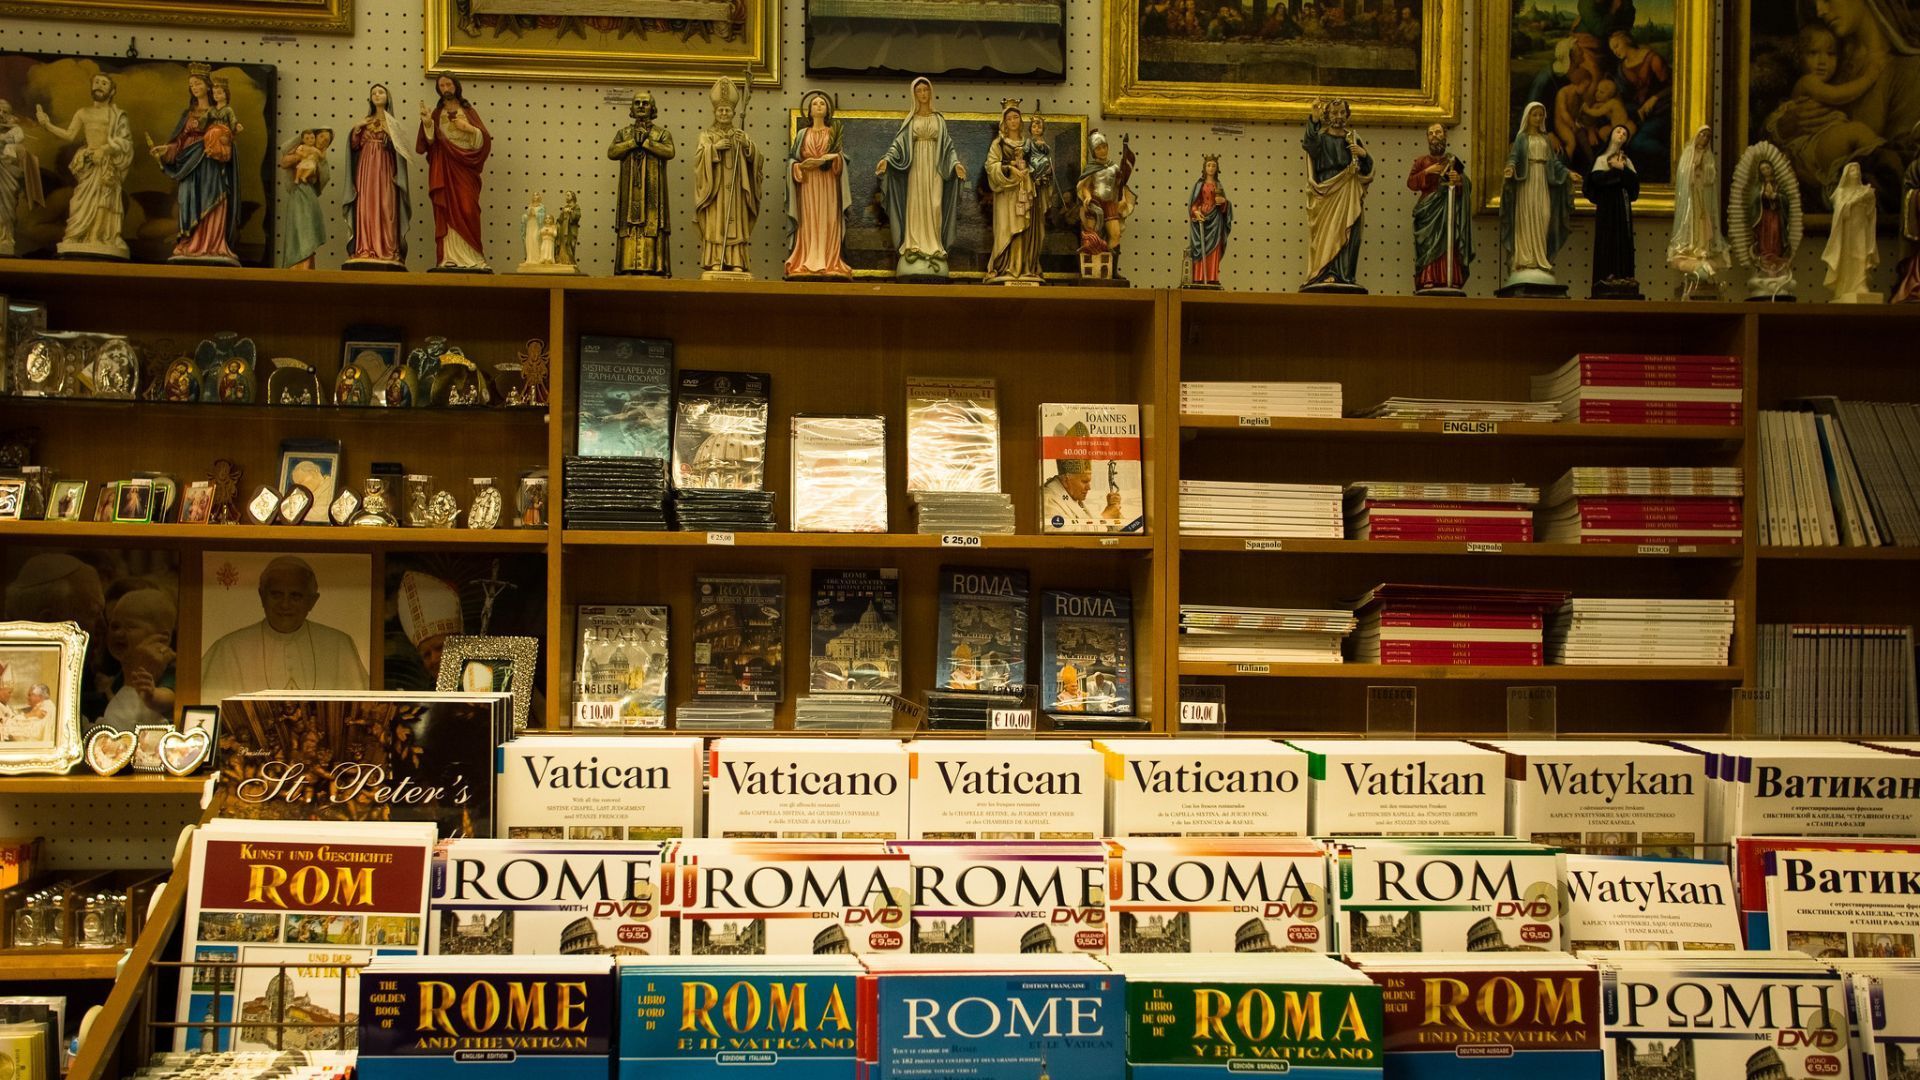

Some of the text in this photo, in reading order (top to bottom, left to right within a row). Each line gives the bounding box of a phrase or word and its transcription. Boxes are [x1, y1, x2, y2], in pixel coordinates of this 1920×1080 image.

[583, 364, 665, 375] SISTINE CHAPEL AND
[628, 374, 659, 383] ROOMS
[981, 390, 990, 399] II
[1086, 412, 1126, 422] IOANNES
[1240, 416, 1269, 426] English
[1090, 424, 1136, 434] PAULUS II
[1443, 422, 1494, 432] ENGLISH
[943, 536, 979, 545] € 25,00
[1246, 540, 1282, 550] Spagnolo
[1467, 543, 1502, 552] Spagnolo
[953, 574, 1014, 595] ROMA
[719, 585, 761, 596] ROMA
[1056, 595, 1117, 616] ROMA
[594, 626, 653, 642] ITALY
[1237, 664, 1268, 672] Italiano
[579, 683, 619, 694] ENGLISH
[1372, 688, 1412, 699] TEDESCO
[1742, 690, 1770, 700] RUSSO
[582, 705, 614, 719] € 10.00
[1182, 704, 1188, 719] €
[995, 712, 1030, 728] € 10.00
[521, 756, 671, 789] Vatican
[936, 761, 1083, 794] Vatican
[1129, 761, 1299, 793] Vaticano
[1341, 761, 1486, 795] Vatikan
[237, 761, 471, 804] St. Peter's
[723, 762, 897, 795] Vaticano
[1533, 761, 1694, 803] Watykan
[1755, 766, 1920, 799] Ватикан
[290, 851, 313, 861] UND
[451, 858, 652, 900] ROME
[1127, 861, 1317, 902] ROMA
[1374, 860, 1525, 901] ROM
[245, 864, 376, 909] ROM
[702, 866, 902, 908] ROMA
[912, 866, 1105, 907] ROME
[1567, 871, 1725, 911] Watykan
[593, 902, 652, 917] DVD
[1264, 903, 1318, 918] DVD
[1496, 903, 1551, 917] DVD
[844, 909, 903, 924] DVD
[1051, 909, 1105, 924] DVD
[308, 953, 352, 963] UND DER
[380, 981, 398, 990] THE
[648, 982, 656, 992] IL
[1388, 979, 1405, 987] DAS
[371, 994, 406, 1003] GOLDEN
[1153, 988, 1164, 998] EL
[1382, 990, 1416, 1000] OLDENE
[638, 996, 665, 1005] LIBRO
[1145, 1001, 1172, 1011] LIBRO
[1419, 977, 1585, 1031] ROM
[1621, 982, 1837, 1030] ΡΩΜΗ
[376, 1006, 400, 1015] BOOK
[416, 980, 588, 1037] ROME
[638, 1008, 665, 1017] D'ORO
[679, 981, 852, 1037] ROMA
[1385, 1003, 1408, 1012] BUCH
[903, 997, 1104, 1038] ROME
[1142, 1014, 1175, 1024] DE ORO
[1192, 989, 1371, 1044] ROMA
[382, 1019, 393, 1028] OF
[646, 1021, 656, 1031] DI
[1153, 1027, 1164, 1036] DE
[1418, 1031, 1587, 1043] UND DER VATIKAN
[416, 1037, 588, 1048] AND THE VATICAN
[677, 1038, 856, 1049] E IL VATICANO
[1777, 1030, 1838, 1047] DVD
[1029, 1041, 1044, 1049] ET
[1192, 1045, 1373, 1060] Y EL VATICANO
